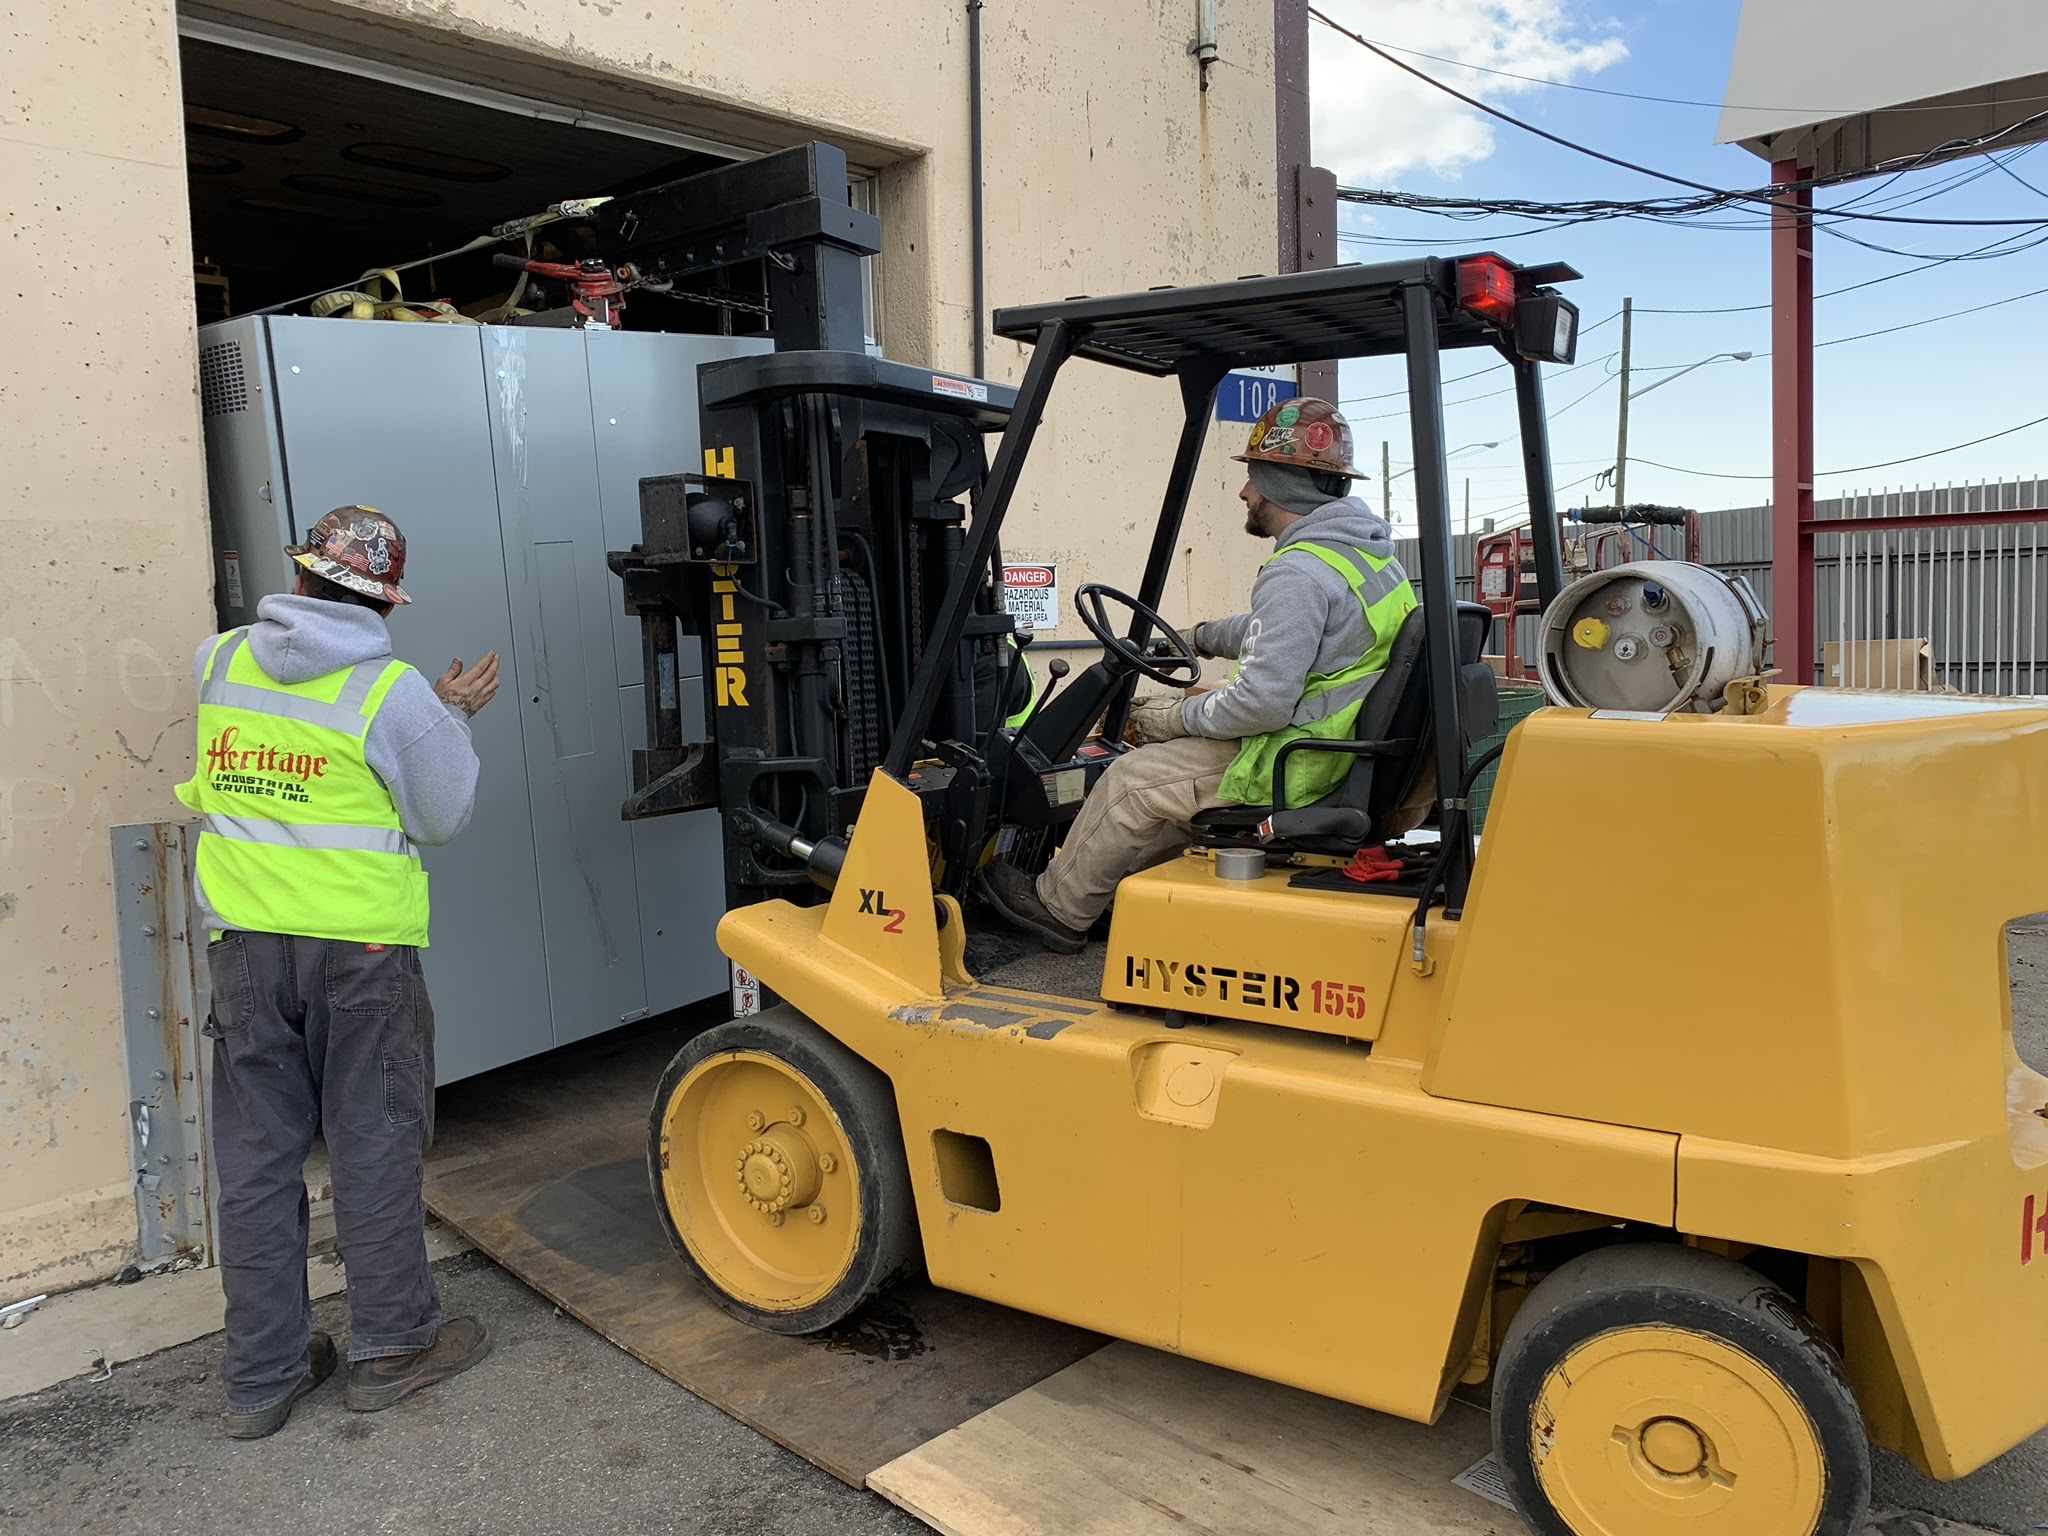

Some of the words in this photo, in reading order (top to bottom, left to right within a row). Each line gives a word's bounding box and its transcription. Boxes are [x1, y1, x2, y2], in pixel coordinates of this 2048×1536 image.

[1239, 379, 1277, 418] 108
[704, 446, 750, 707] HTER
[1004, 571, 1047, 583] DANGER
[1004, 588, 1049, 600] HAZARDOUS
[1008, 601, 1045, 612] MATERIAL
[1033, 613, 1048, 622] AREA
[206, 726, 329, 782] Heritage
[216, 773, 305, 793] INDUSTRIAL
[282, 793, 313, 804] INC.
[1126, 956, 1300, 1012] HYSTER
[1310, 980, 1366, 1020] 155
